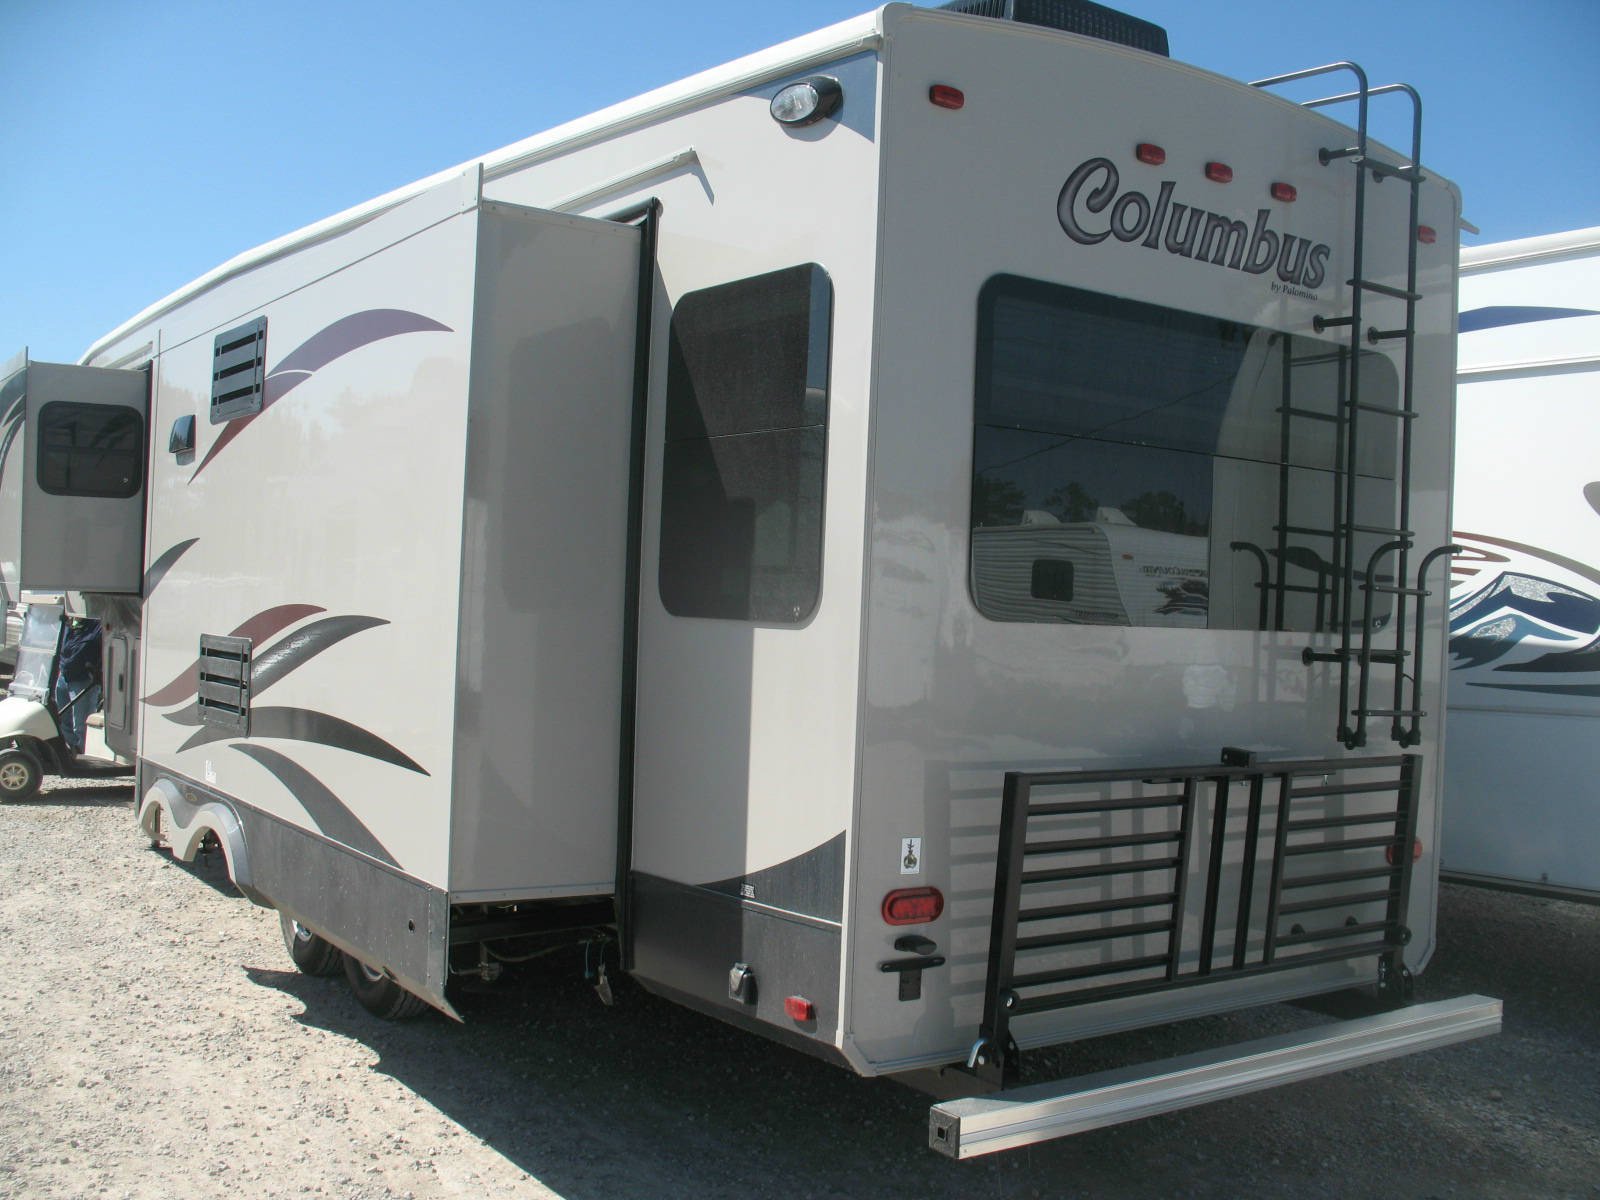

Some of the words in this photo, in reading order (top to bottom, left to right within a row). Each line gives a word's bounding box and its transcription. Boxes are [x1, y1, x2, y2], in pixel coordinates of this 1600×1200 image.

[1057, 157, 1331, 289] Columbus
[1271, 281, 1281, 293] by
[1282, 284, 1318, 301] Palomino
